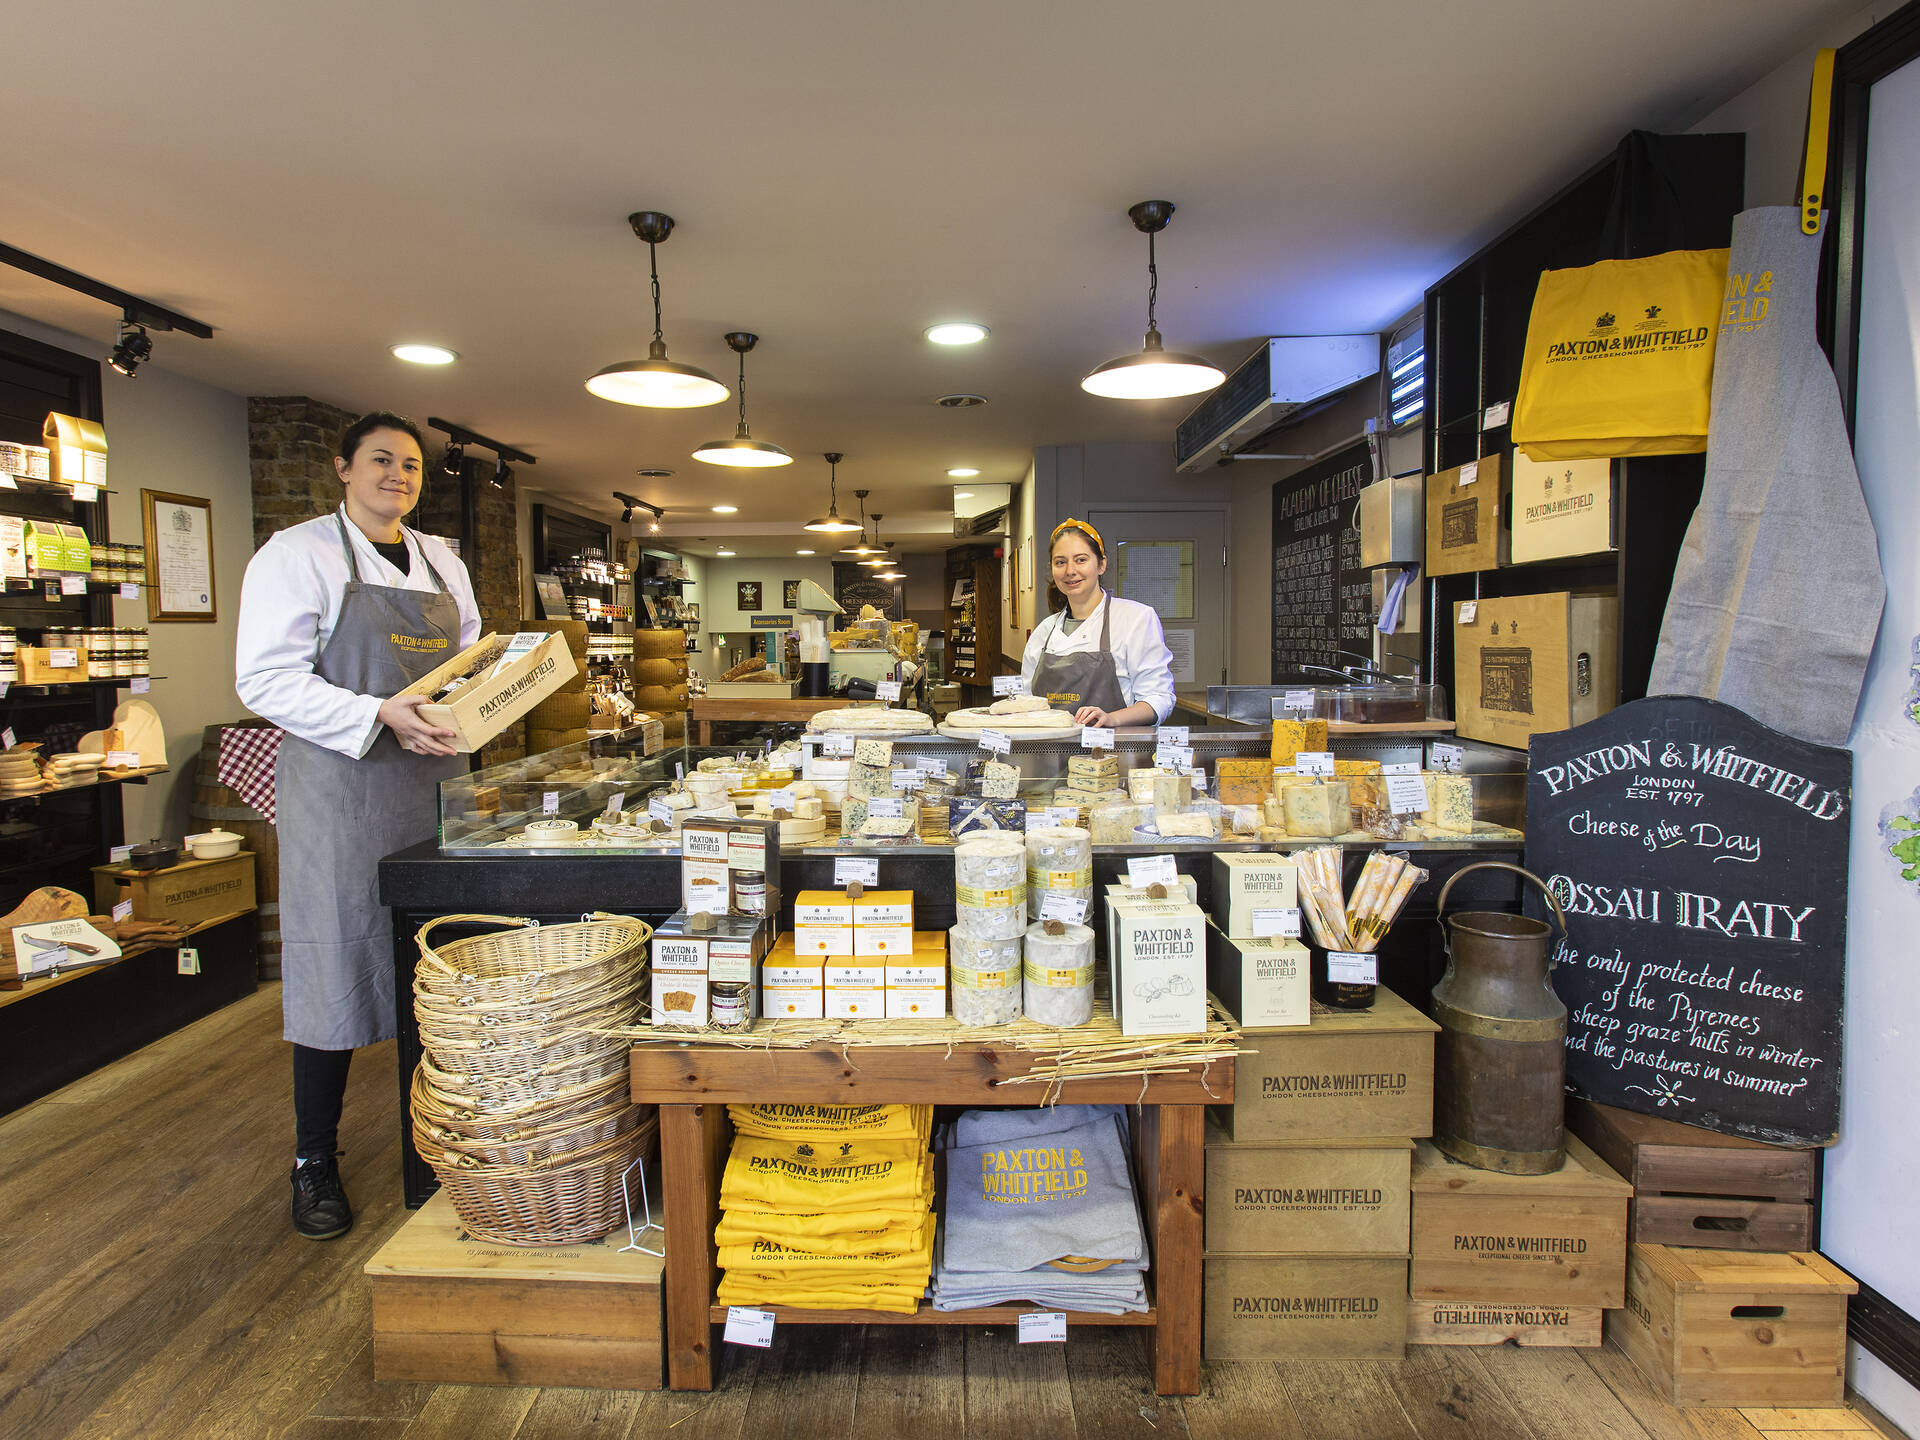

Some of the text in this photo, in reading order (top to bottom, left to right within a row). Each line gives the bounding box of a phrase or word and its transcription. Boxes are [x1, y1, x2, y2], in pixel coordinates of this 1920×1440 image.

[1546, 356, 1578, 364] LONDON
[1683, 342, 1706, 351] 1797
[1280, 463, 1364, 521] ACADEMY OF CHEESE
[1538, 740, 1845, 821] PAXTON & WHITFIELD
[1632, 775, 1695, 790] LONDON
[1667, 791, 1705, 807] 1797
[689, 835, 714, 844] PAXTON
[1569, 810, 1762, 860] Cheese of the Day
[689, 843, 720, 852] WHITFIELD
[1244, 873, 1283, 882] PAXTON &
[1244, 881, 1283, 890] WHITFIELD
[1545, 873, 1816, 942] OSSAU IRATY
[1134, 927, 1193, 942] PAXTON &
[661, 945, 697, 954] PAXTON &
[1134, 941, 1194, 956] WHITFIELD
[661, 954, 698, 963] WHITFIELD
[1256, 958, 1296, 968] PAXTON &
[1256, 967, 1296, 977] WHITFIELD
[1587, 948, 1630, 987] only
[1637, 960, 1736, 993] protected
[1739, 968, 1803, 1002] cheese
[1602, 982, 1762, 1036] of the Pyrenees
[1572, 1002, 1824, 1071] sheep graze hills in winter
[1594, 1035, 1617, 1060] the
[1611, 1046, 1702, 1080] pastures
[1703, 1060, 1721, 1082] in
[1723, 1070, 1808, 1097] summer
[751, 1111, 778, 1122] LONDON
[863, 1112, 881, 1122] 1797
[752, 1119, 782, 1130] LONDON
[870, 1121, 887, 1129] 1797
[982, 1147, 1085, 1172] PAXTON &
[872, 1173, 890, 1181] 1797
[982, 1169, 1088, 1195] WHITFIELD
[1061, 1189, 1087, 1200] 1797
[555, 1251, 581, 1259] LONDON
